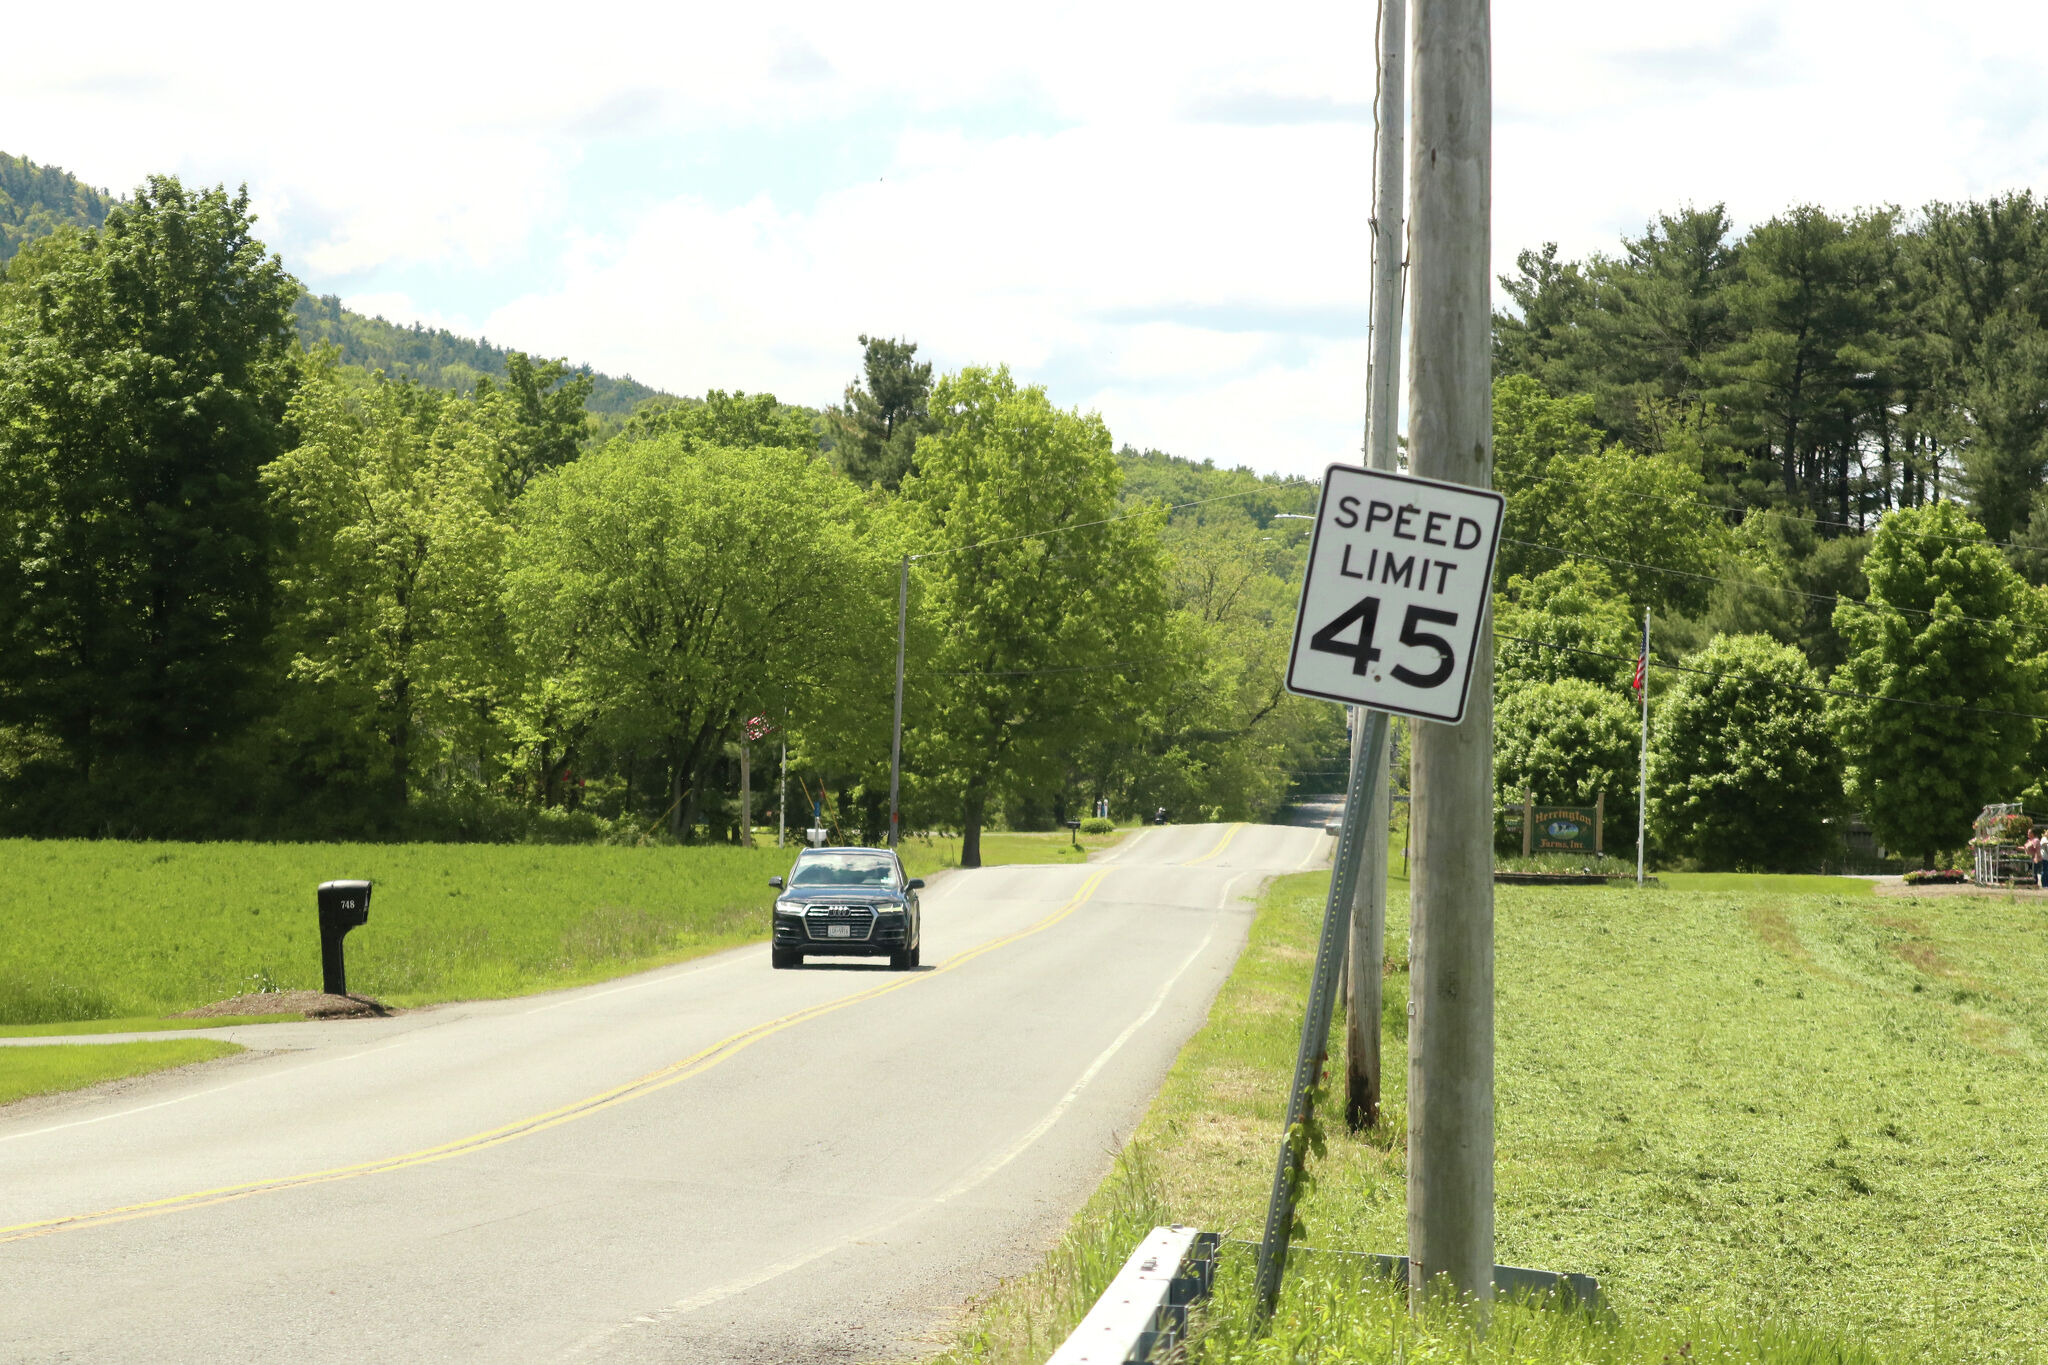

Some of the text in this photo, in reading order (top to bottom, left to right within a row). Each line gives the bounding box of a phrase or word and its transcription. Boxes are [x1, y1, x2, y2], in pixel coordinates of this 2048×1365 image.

[1334, 496, 1482, 550] SPEED
[1340, 544, 1458, 594] LIMIT
[1310, 596, 1459, 688] 45
[1535, 810, 1592, 826] Herrington
[340, 900, 355, 909] 748
